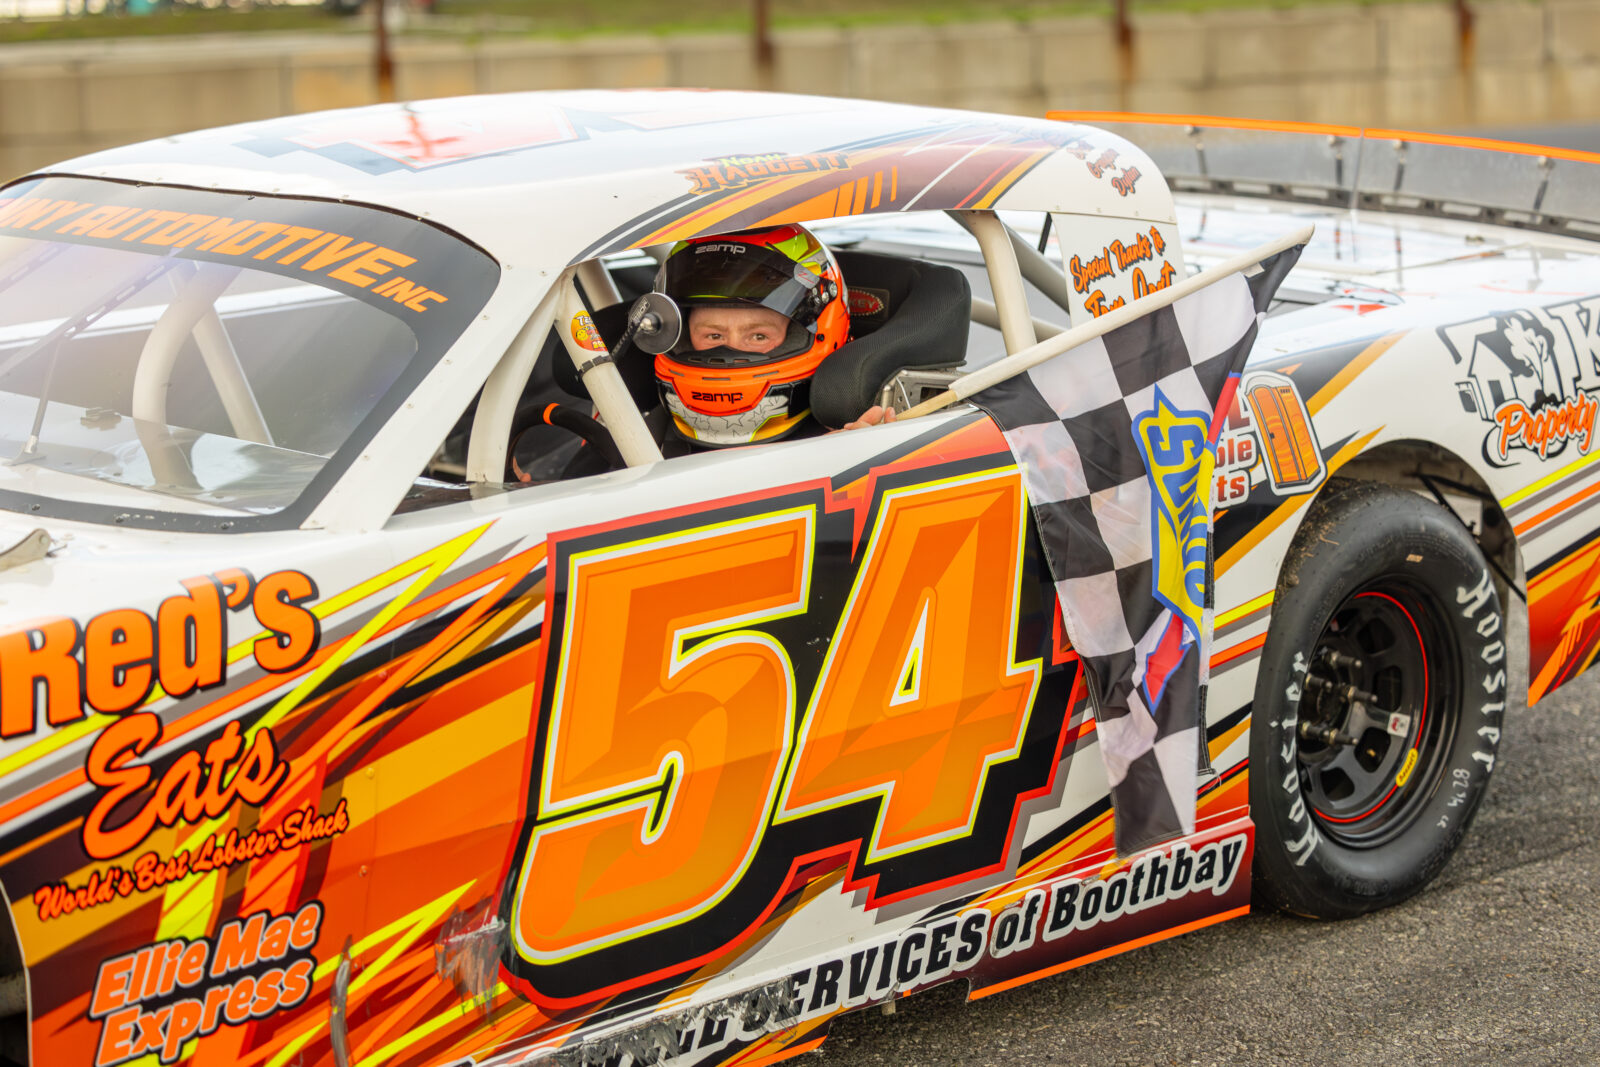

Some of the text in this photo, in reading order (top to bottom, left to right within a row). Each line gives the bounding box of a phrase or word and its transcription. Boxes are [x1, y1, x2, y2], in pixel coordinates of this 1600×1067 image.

[0, 197, 449, 313] NY AUTOMOTIVE INC
[1070, 246, 1115, 294] Special
[1109, 232, 1153, 272] Thanks
[1148, 225, 1167, 256] To
[691, 391, 743, 404] zamp
[1495, 392, 1598, 457] Property
[0, 567, 320, 740] Red's
[1455, 568, 1507, 774] Hoosier
[510, 463, 1043, 967] 54
[82, 710, 290, 861] Eats
[33, 798, 349, 921] World's Best Lobster Shack
[994, 896, 1040, 953] of
[1049, 840, 1243, 934] Boothbay
[90, 902, 322, 1018] Ellie Mae
[95, 957, 314, 1067] Express
